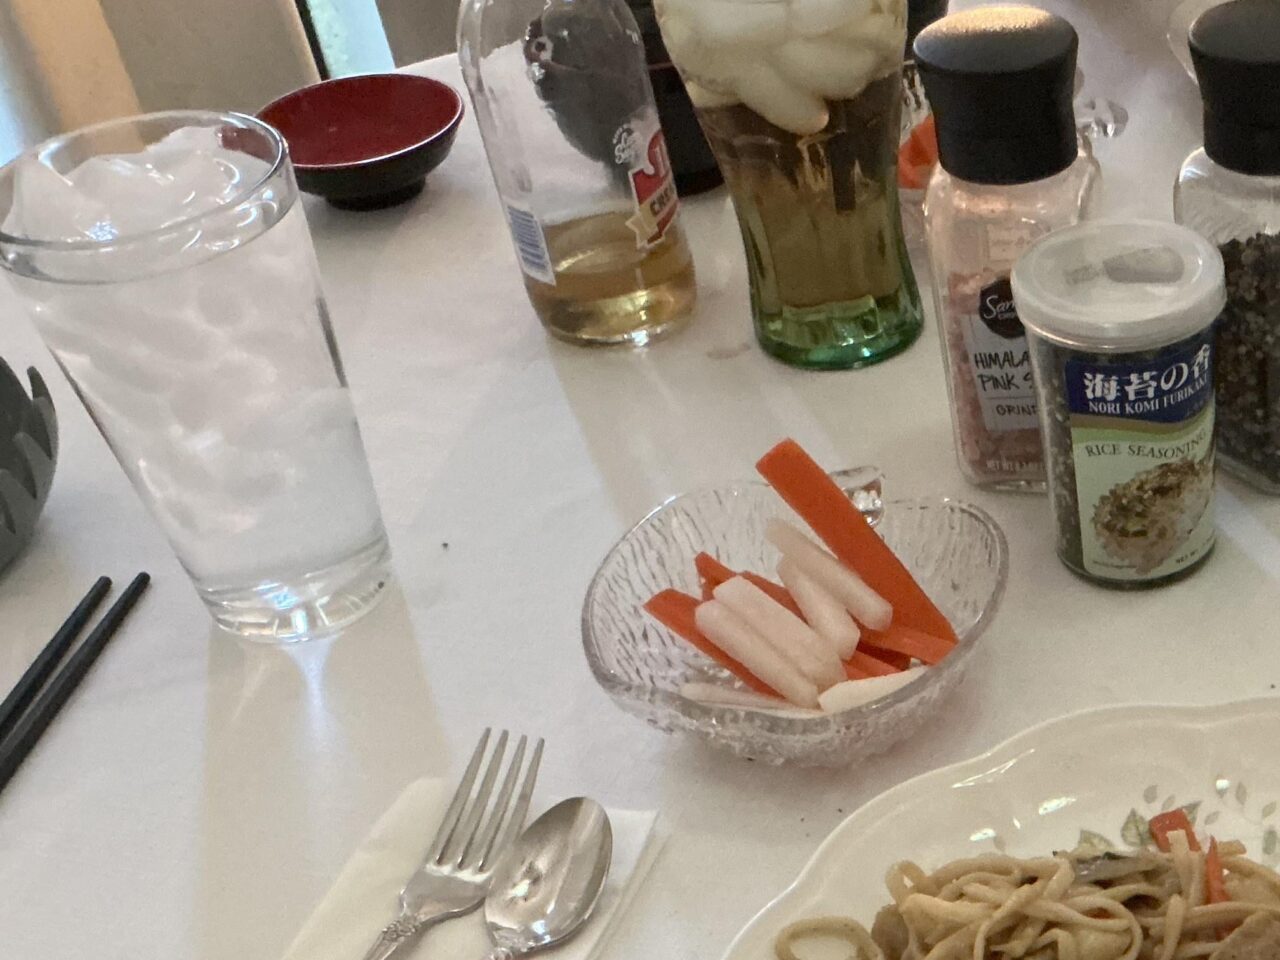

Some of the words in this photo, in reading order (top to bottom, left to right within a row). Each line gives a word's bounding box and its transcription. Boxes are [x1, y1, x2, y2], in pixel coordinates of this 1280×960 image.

[973, 350, 1030, 370] HIMALA
[977, 372, 1021, 392] PINK
[1088, 400, 1121, 415] NORI
[1125, 398, 1160, 415] KOMI
[1084, 442, 1122, 458] RICE
[1127, 425, 1208, 460] SEASONING
